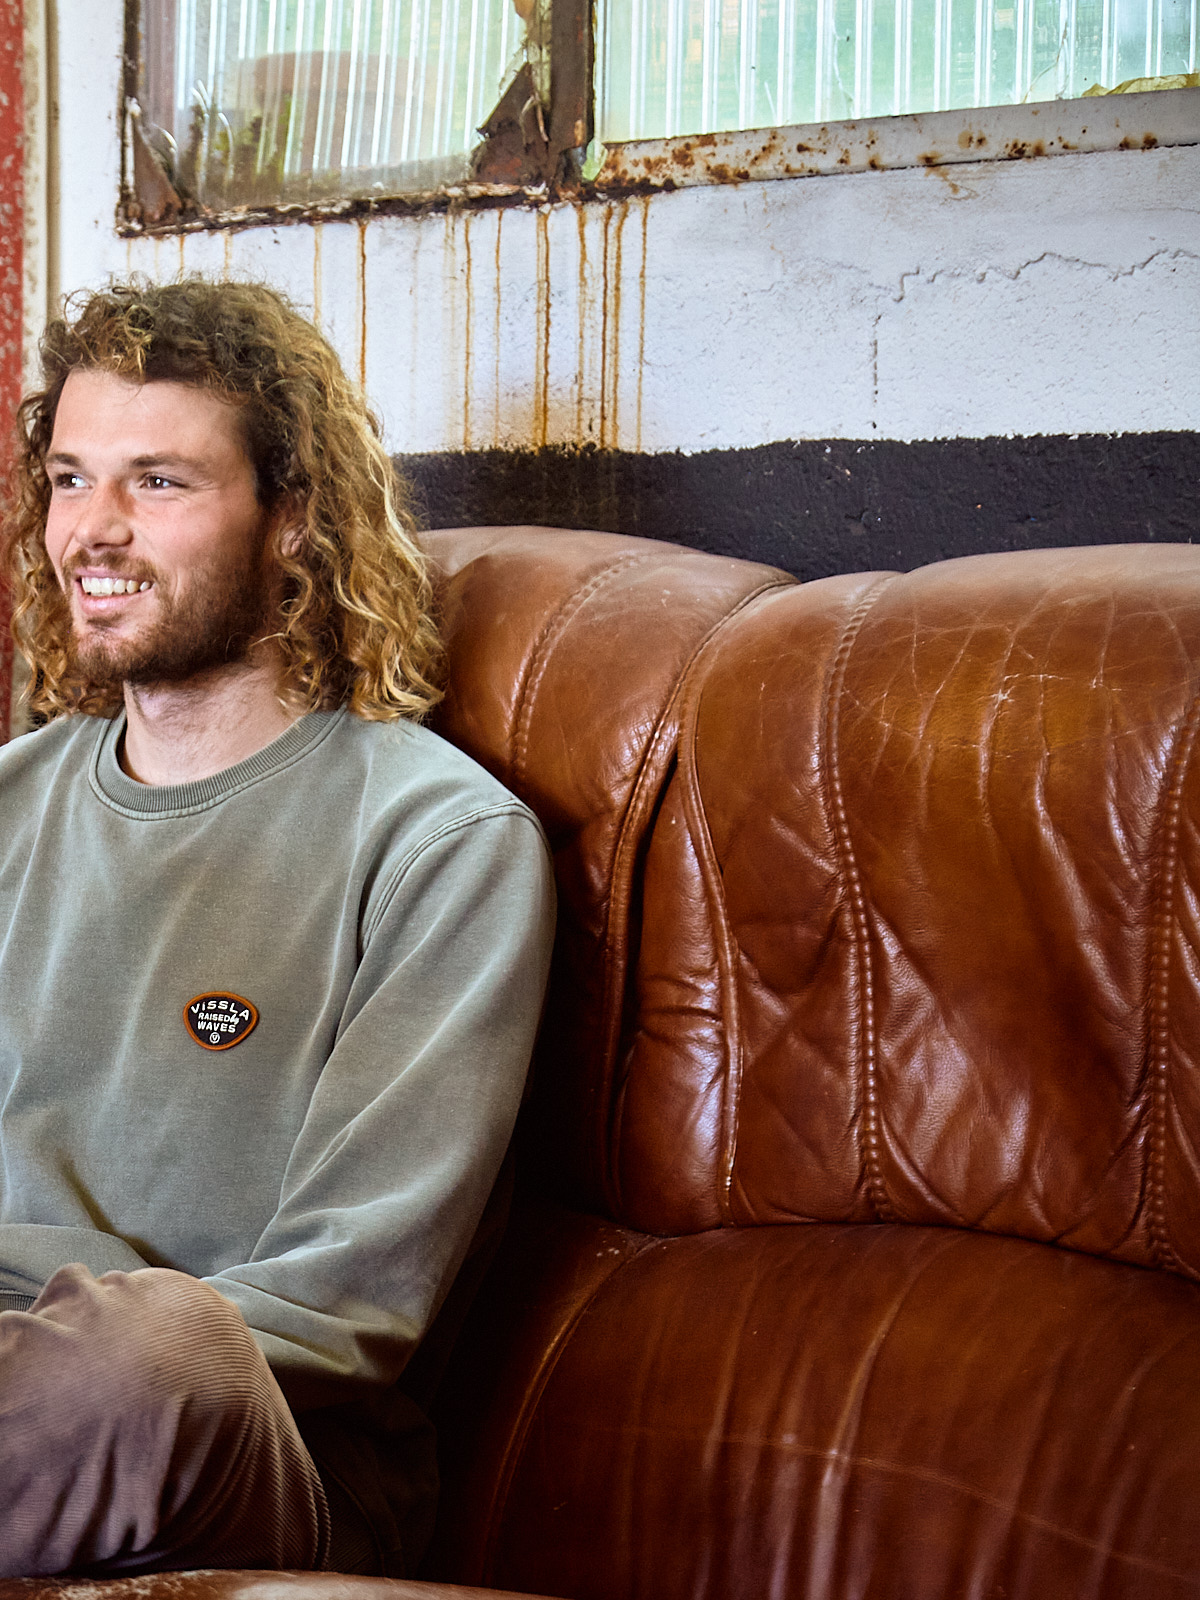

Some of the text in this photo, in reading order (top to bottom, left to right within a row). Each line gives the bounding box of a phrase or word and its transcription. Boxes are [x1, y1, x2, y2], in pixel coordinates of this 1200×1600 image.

[191, 1000, 250, 1021] VISSLA
[198, 1012, 230, 1023] RAISED
[197, 1020, 236, 1034] WAVES
